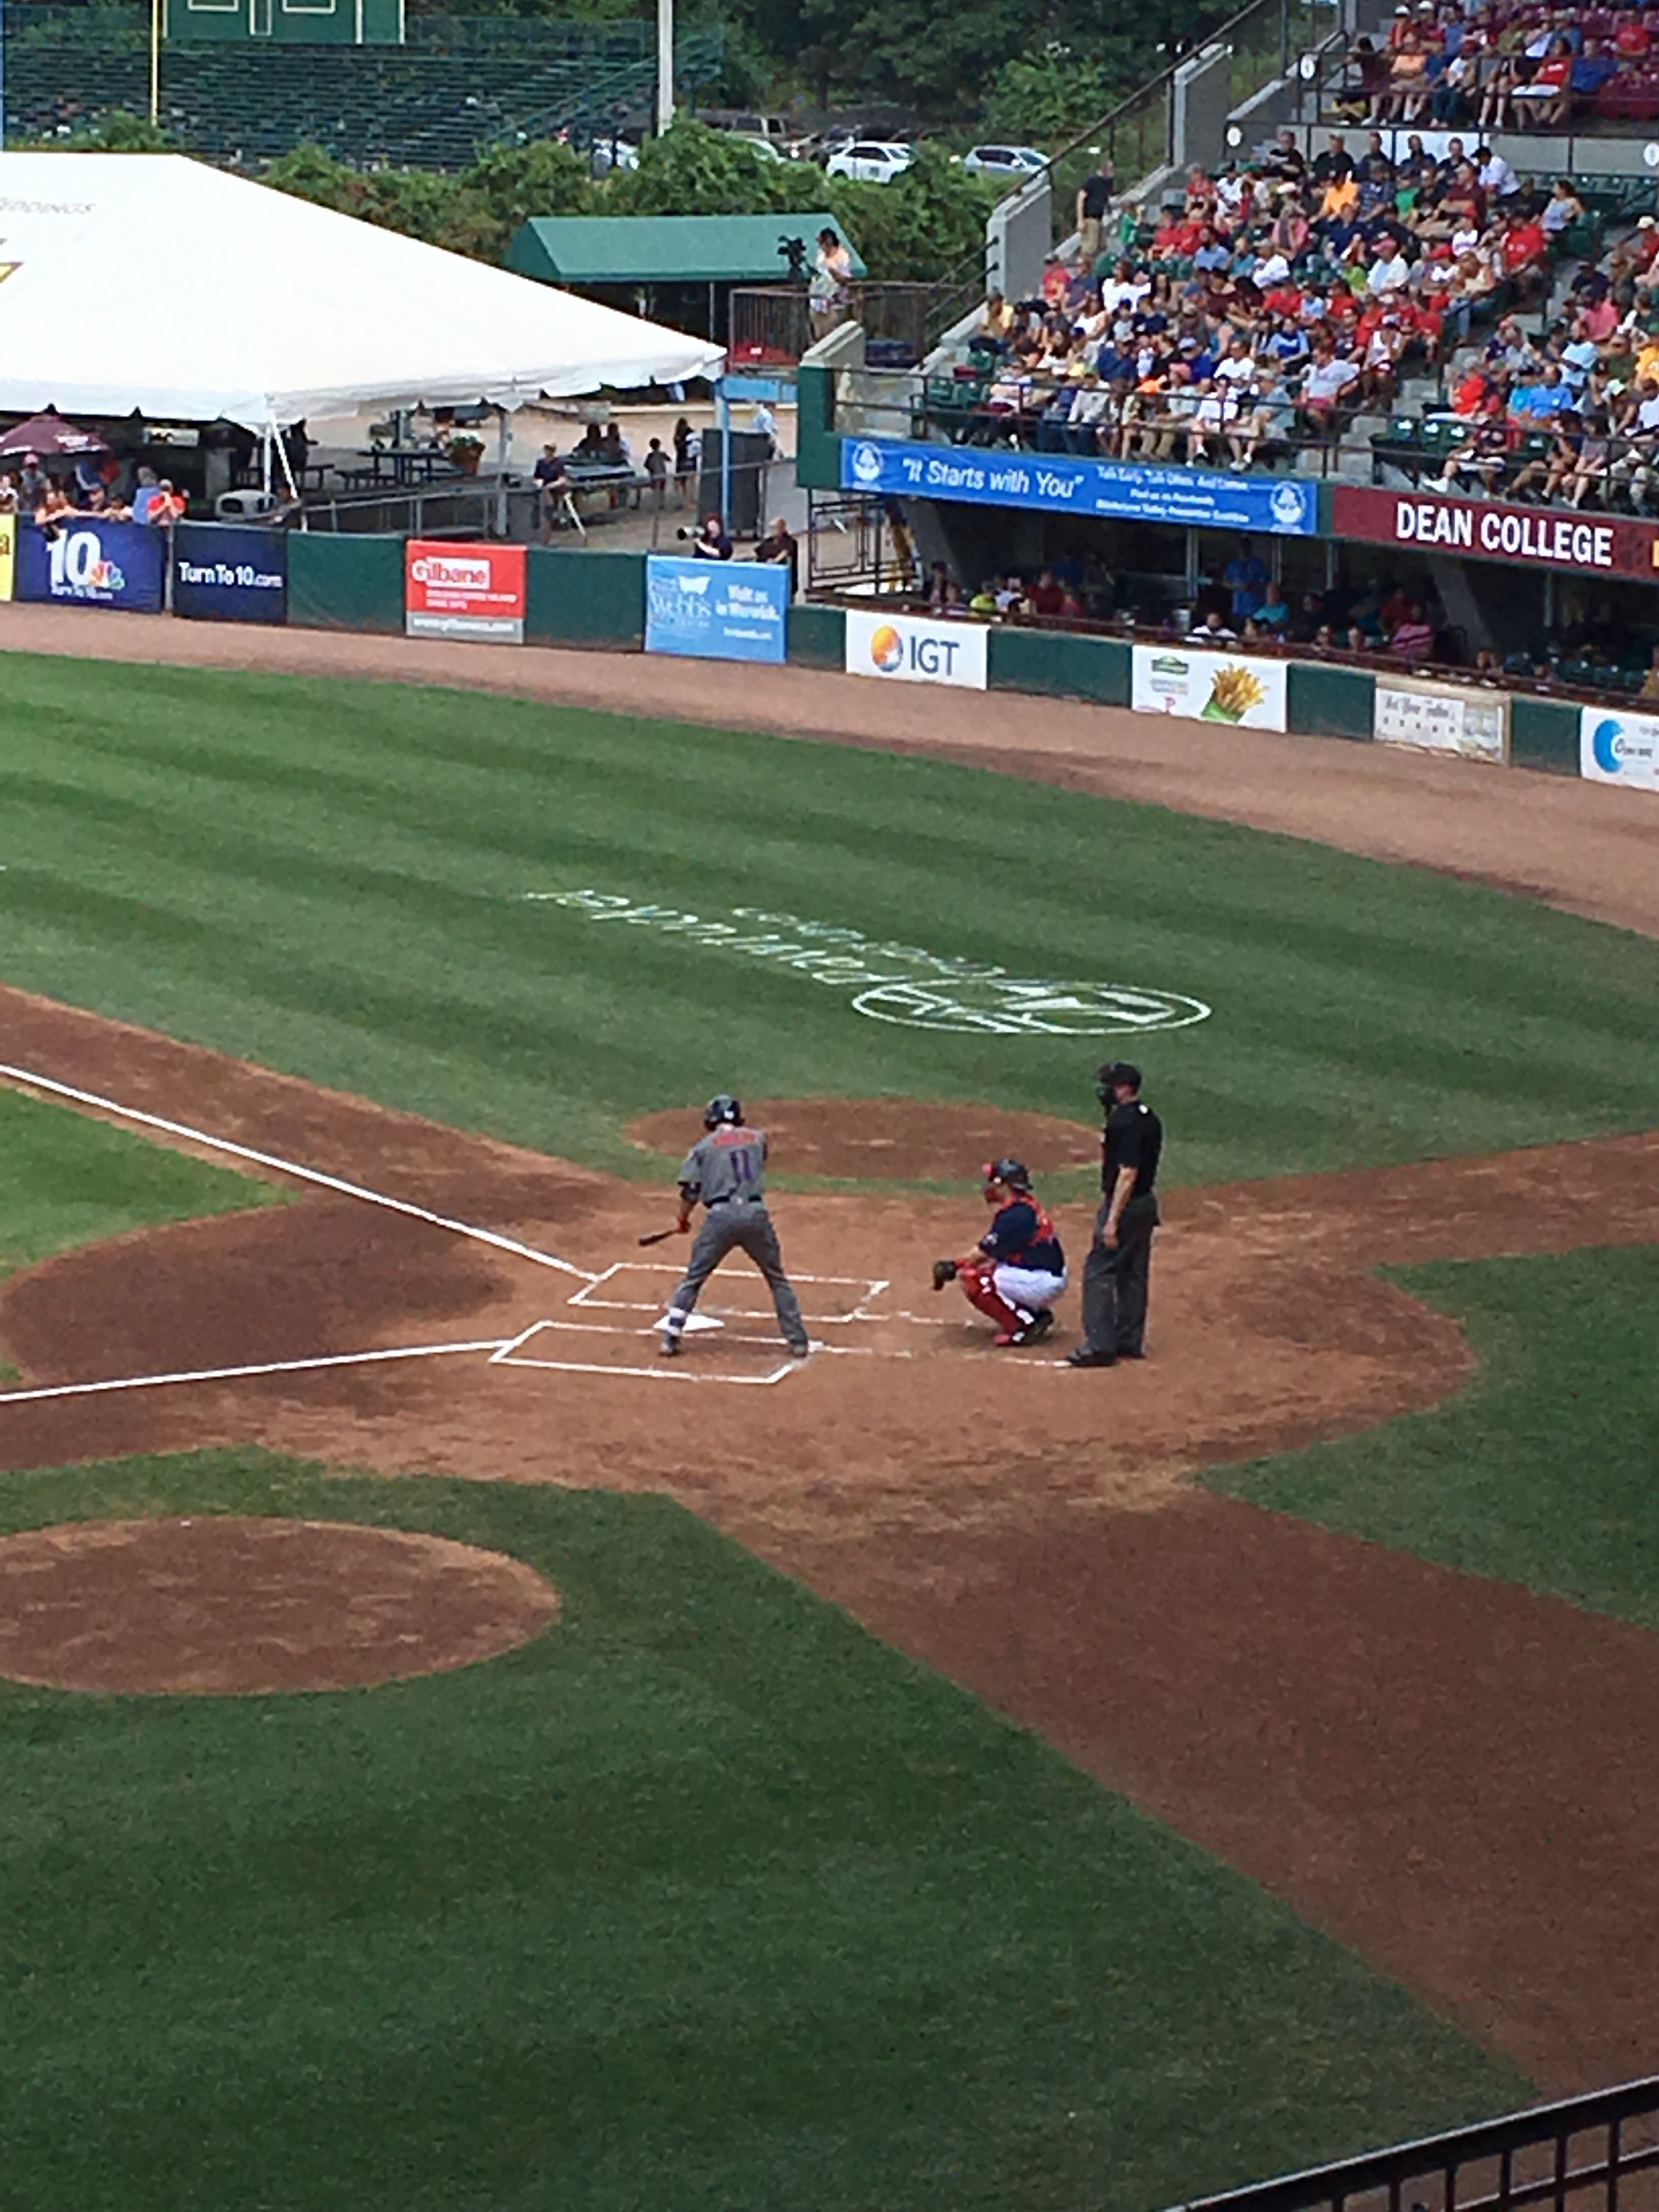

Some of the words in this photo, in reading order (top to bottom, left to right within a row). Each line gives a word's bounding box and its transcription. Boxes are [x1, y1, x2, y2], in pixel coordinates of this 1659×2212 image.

[926, 460, 984, 490] Starts
[990, 468, 1029, 494] with
[1396, 501, 1472, 548] DEAN
[1480, 513, 1614, 566] COLLEGE
[911, 636, 960, 676] IGT
[730, 1149, 752, 1181] 11
